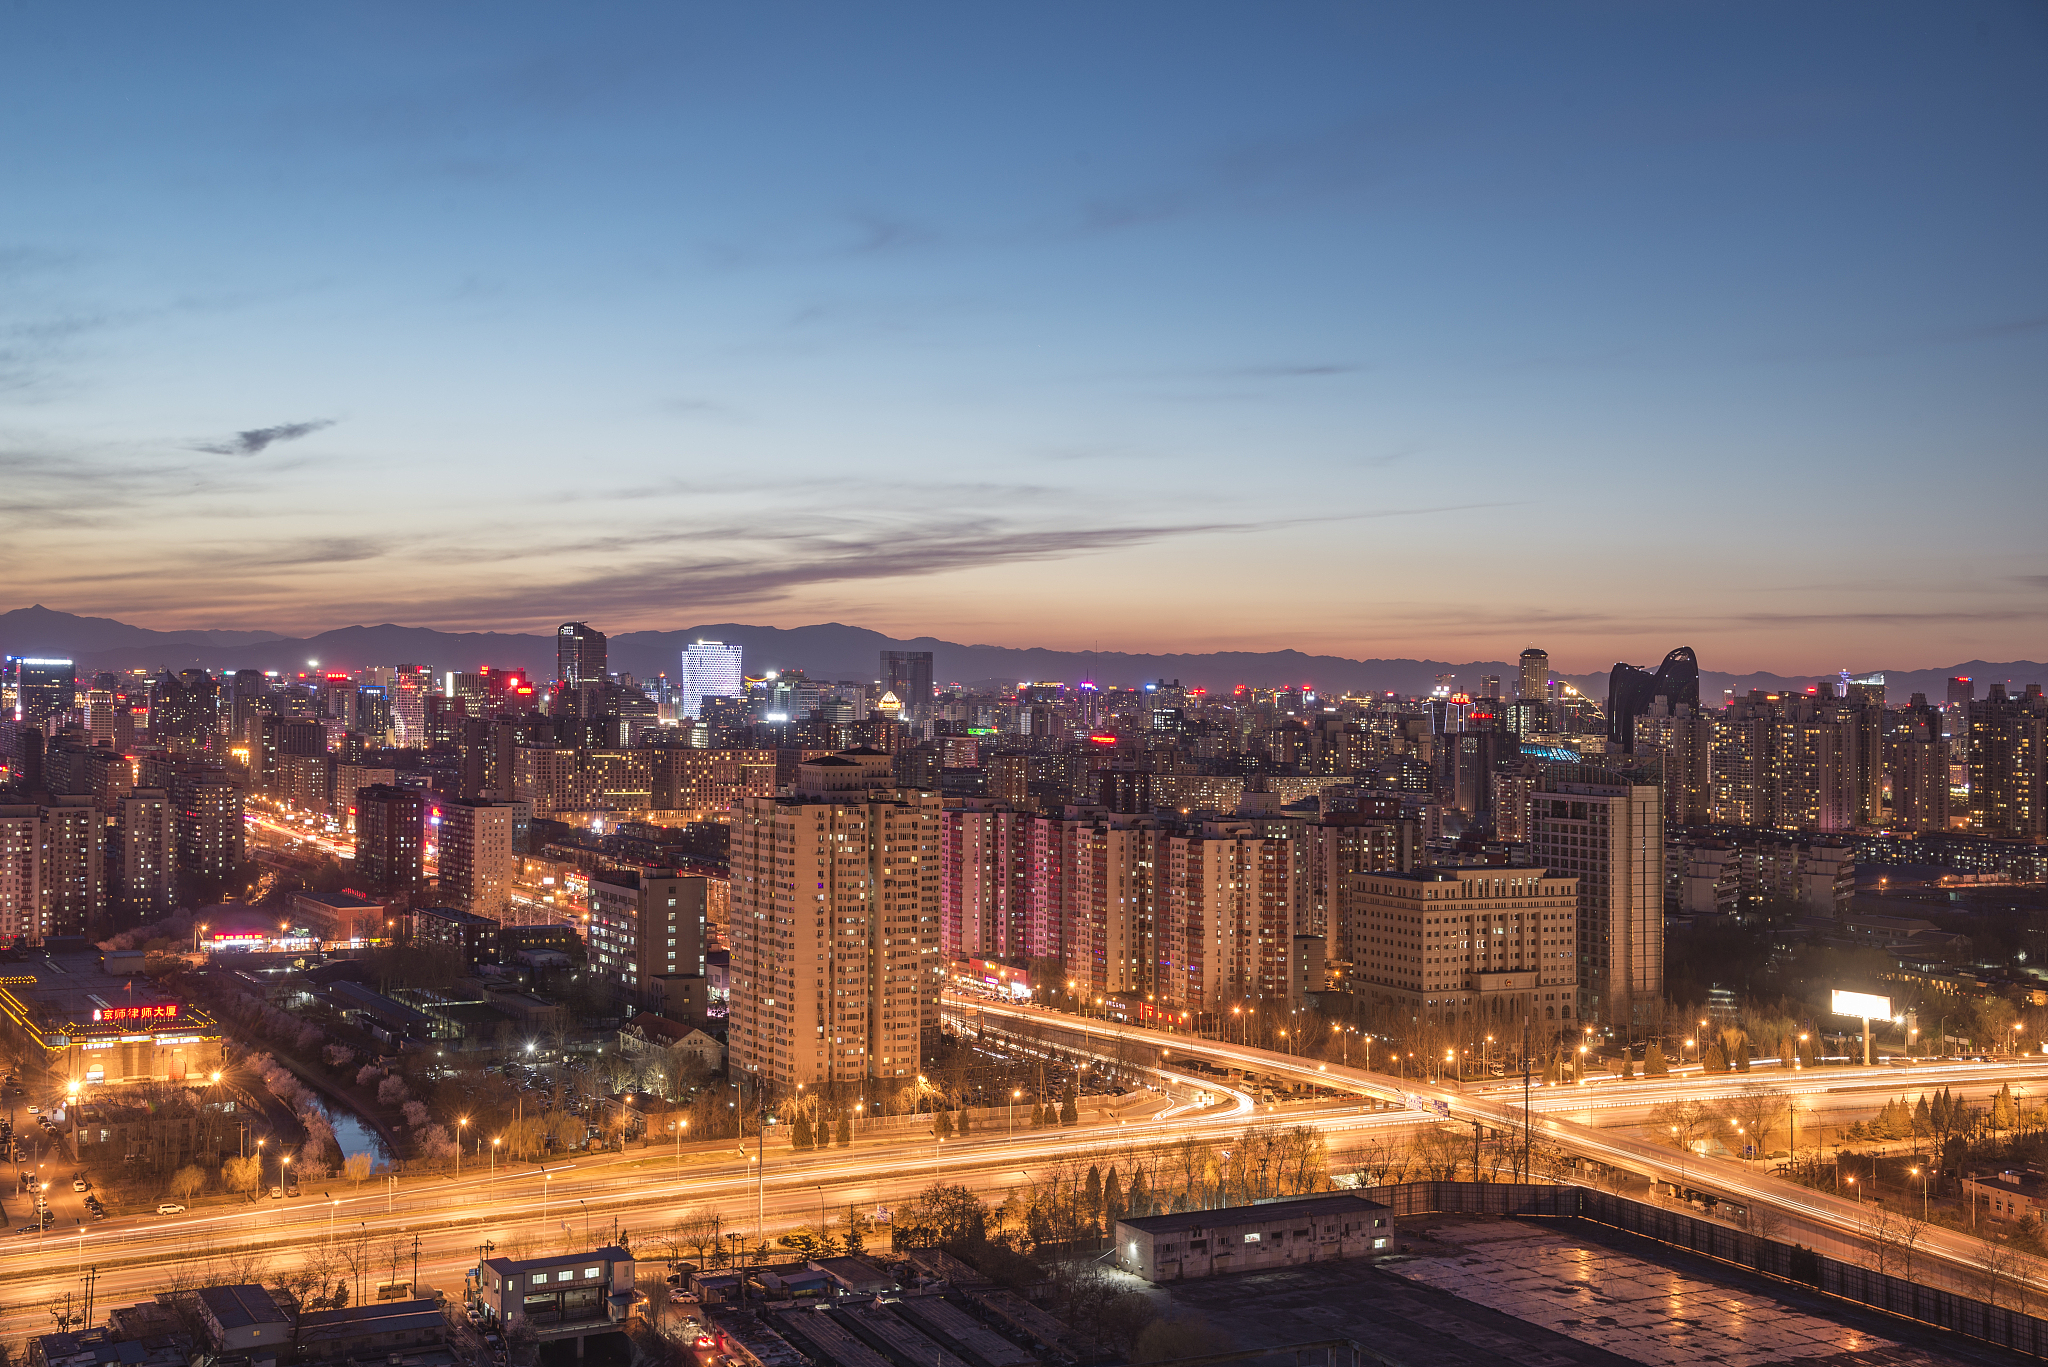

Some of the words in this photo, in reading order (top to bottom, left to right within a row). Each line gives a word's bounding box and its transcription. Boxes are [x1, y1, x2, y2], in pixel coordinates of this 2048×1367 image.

[102, 1005, 177, 1020] 京师律师大厦
